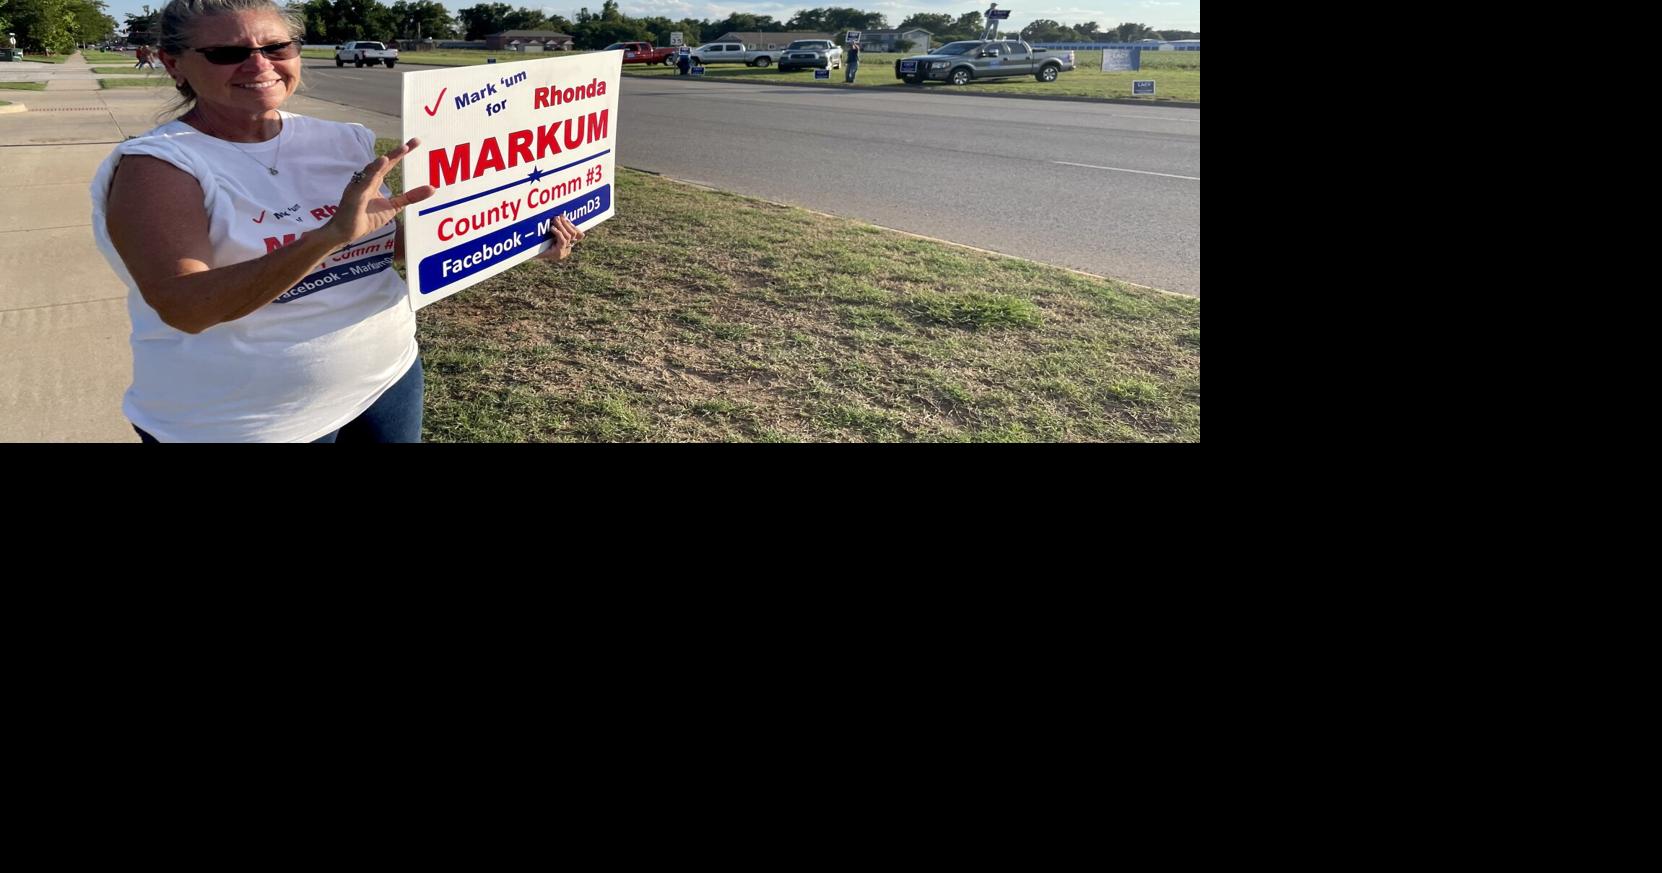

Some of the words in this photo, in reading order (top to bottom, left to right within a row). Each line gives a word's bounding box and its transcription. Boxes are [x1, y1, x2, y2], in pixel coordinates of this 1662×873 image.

[454, 83, 497, 110] Mark
[485, 100, 507, 117] for
[533, 78, 607, 110] Rhonda
[428, 109, 609, 189] MARKUM
[437, 199, 522, 242] County
[527, 176, 582, 209] Comm
[586, 164, 603, 187] #3
[442, 233, 522, 278] Facebook
[537, 196, 601, 237] MkumD3
[276, 272, 341, 301] acebook
